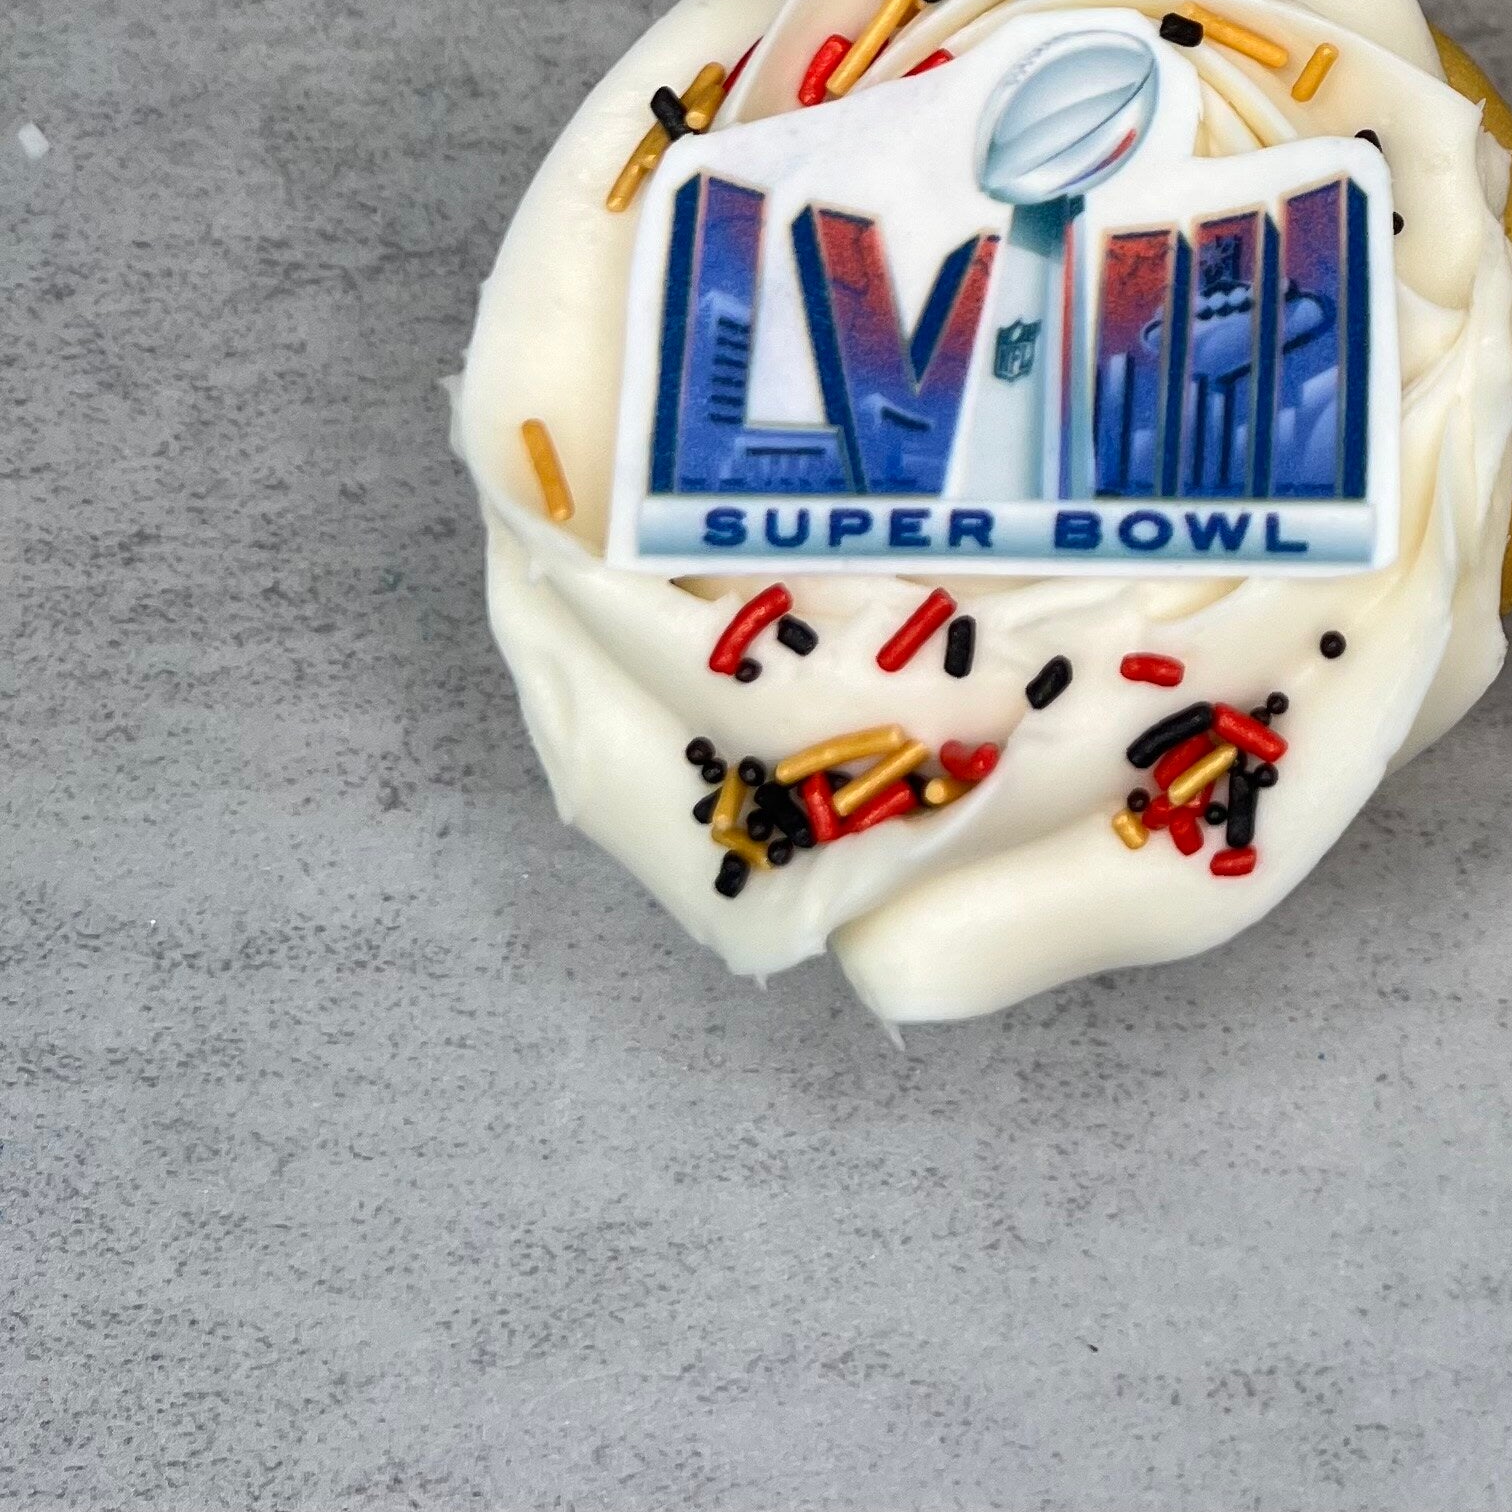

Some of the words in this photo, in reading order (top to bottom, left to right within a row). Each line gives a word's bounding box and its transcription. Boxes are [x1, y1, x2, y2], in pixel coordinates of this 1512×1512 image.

[646, 169, 1371, 502] LVIII
[702, 506, 997, 550] SUPER
[1053, 509, 1310, 555] BOWL
